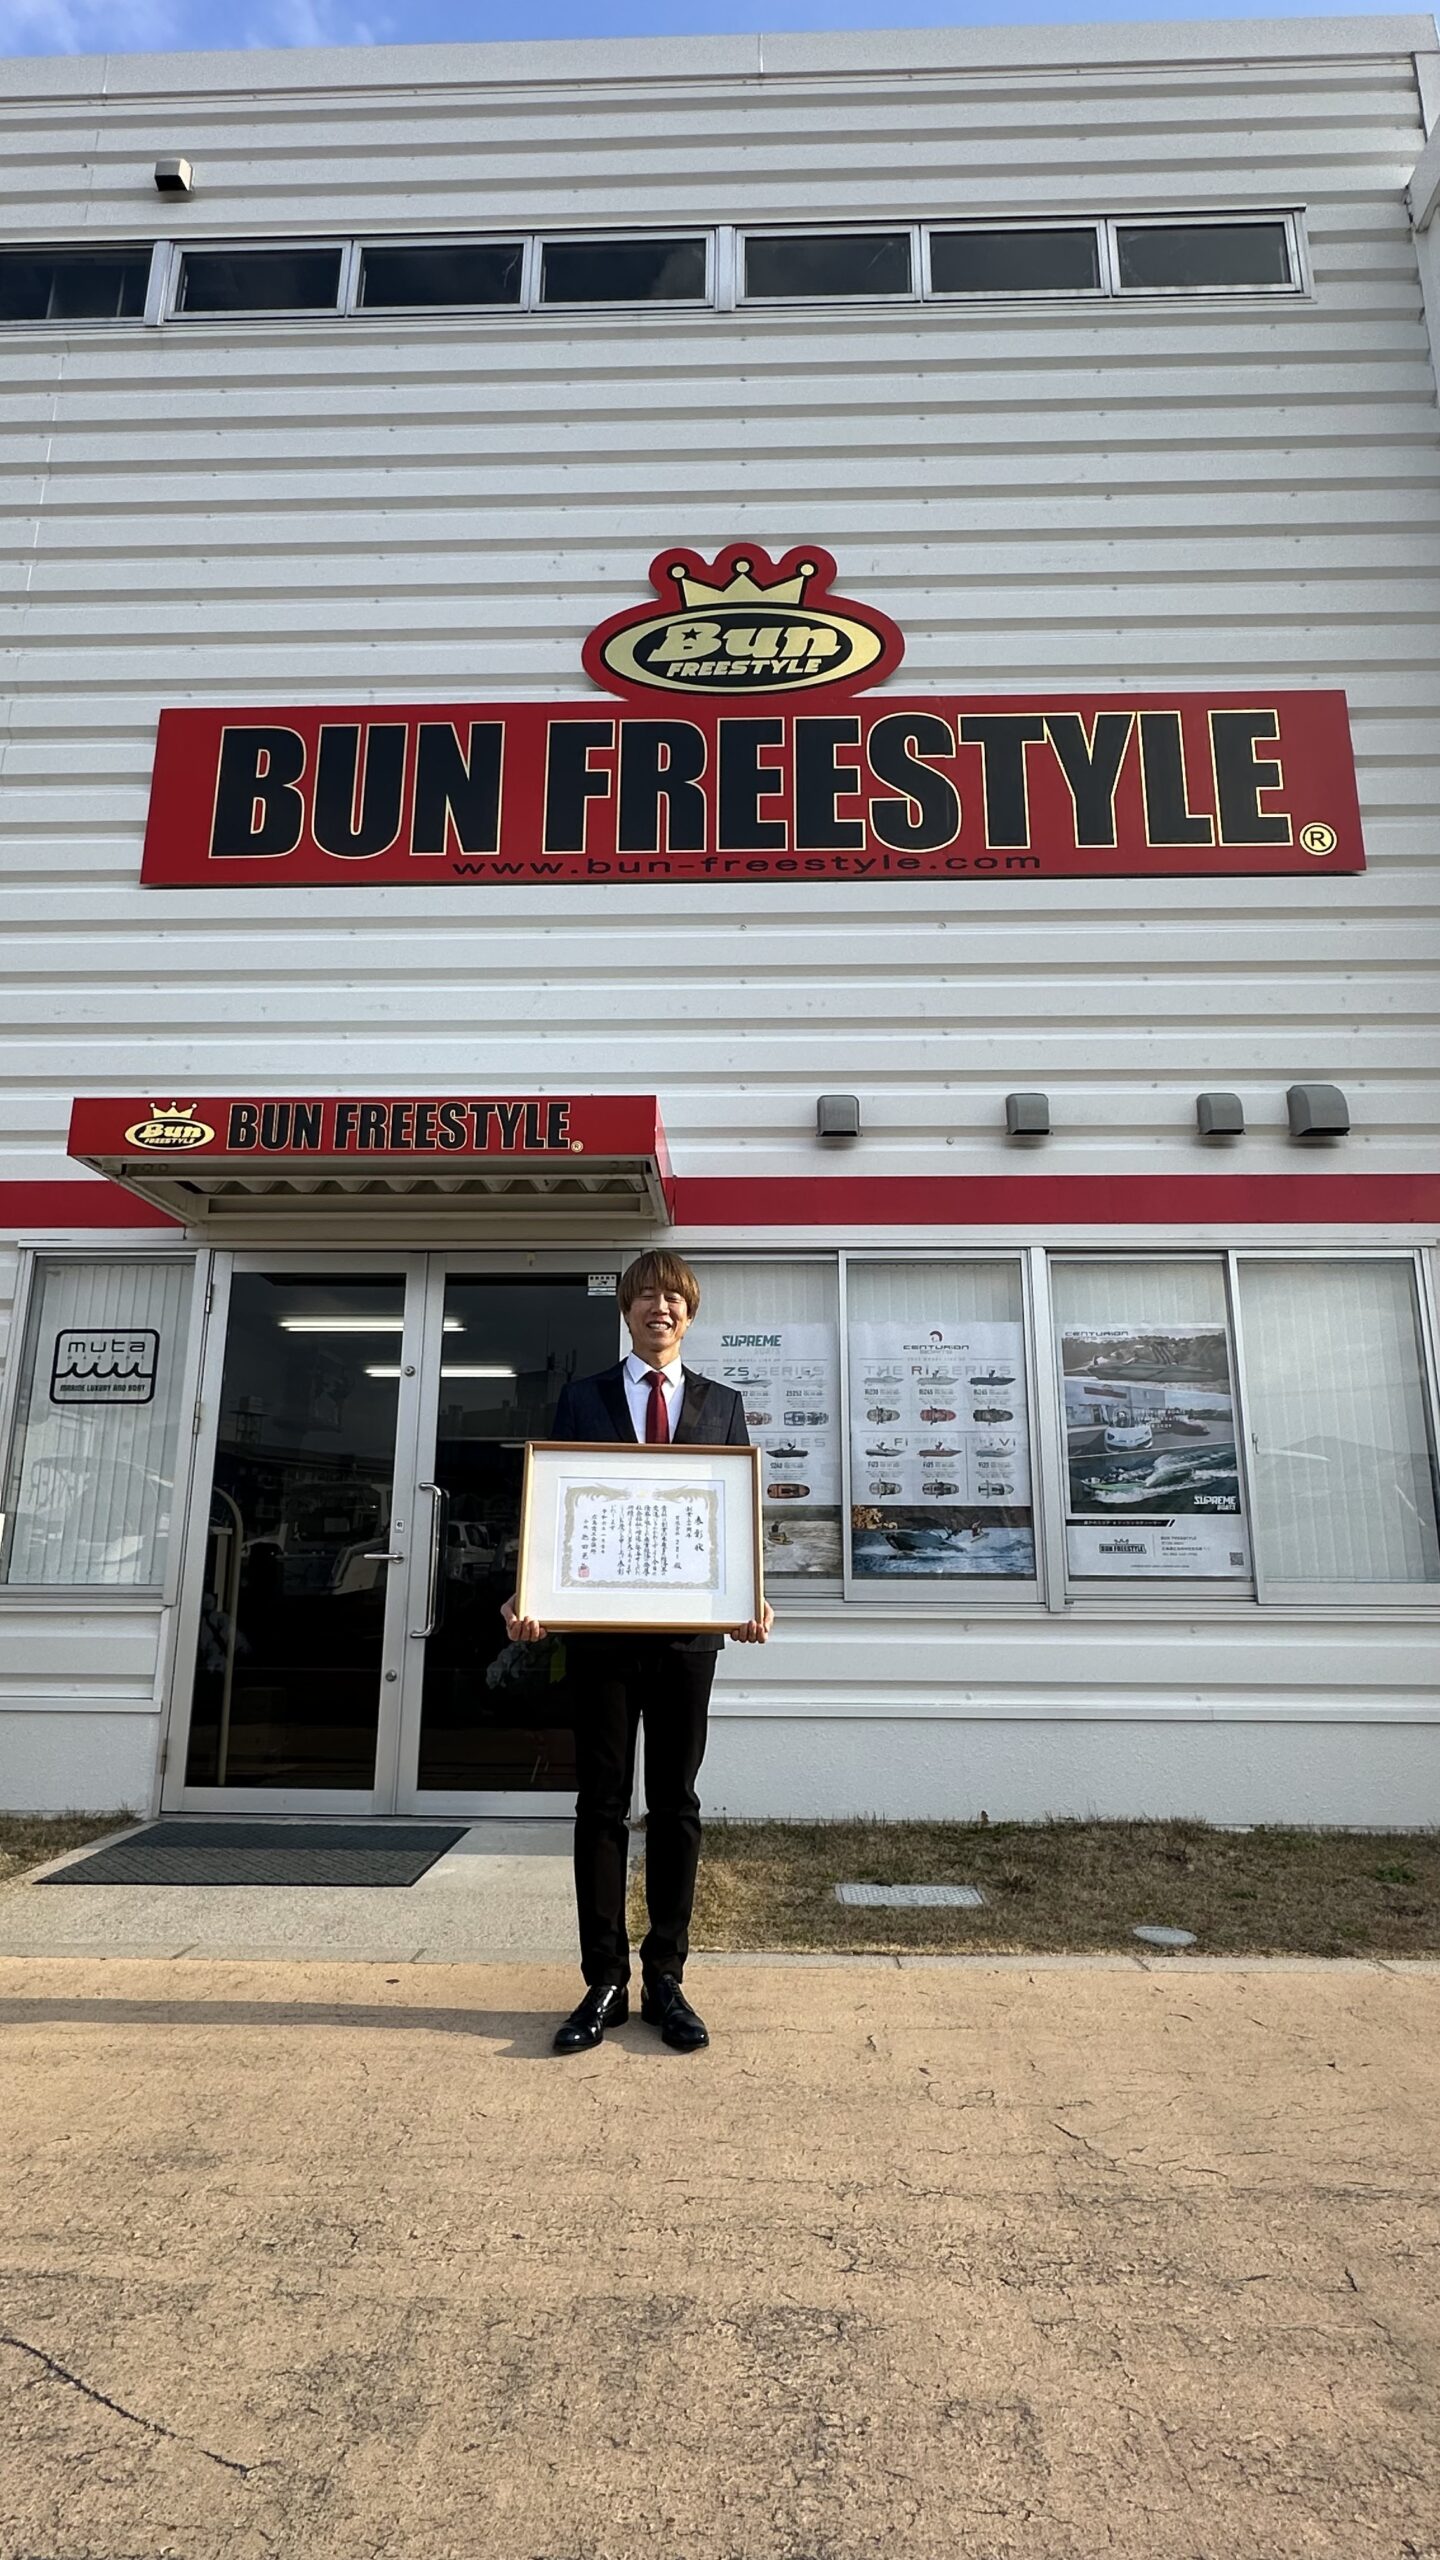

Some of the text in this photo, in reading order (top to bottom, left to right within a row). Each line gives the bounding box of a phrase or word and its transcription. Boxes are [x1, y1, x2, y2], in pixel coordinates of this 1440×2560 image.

[648, 622, 841, 662] Bun
[667, 658, 822, 677] FREESTYLE
[208, 721, 505, 859] BUN
[542, 709, 1292, 856] FREESTYLE
[453, 855, 1040, 874] www.bun-freestyle.com
[138, 1124, 202, 1138] Bun
[227, 1103, 323, 1151] BUN
[333, 1102, 571, 1150] FREESTYLE
[68, 1339, 146, 1353] muta
[721, 1335, 782, 1347] SUPREME
[723, 1367, 750, 1377] ZS
[1193, 1495, 1237, 1505] SUPREME
